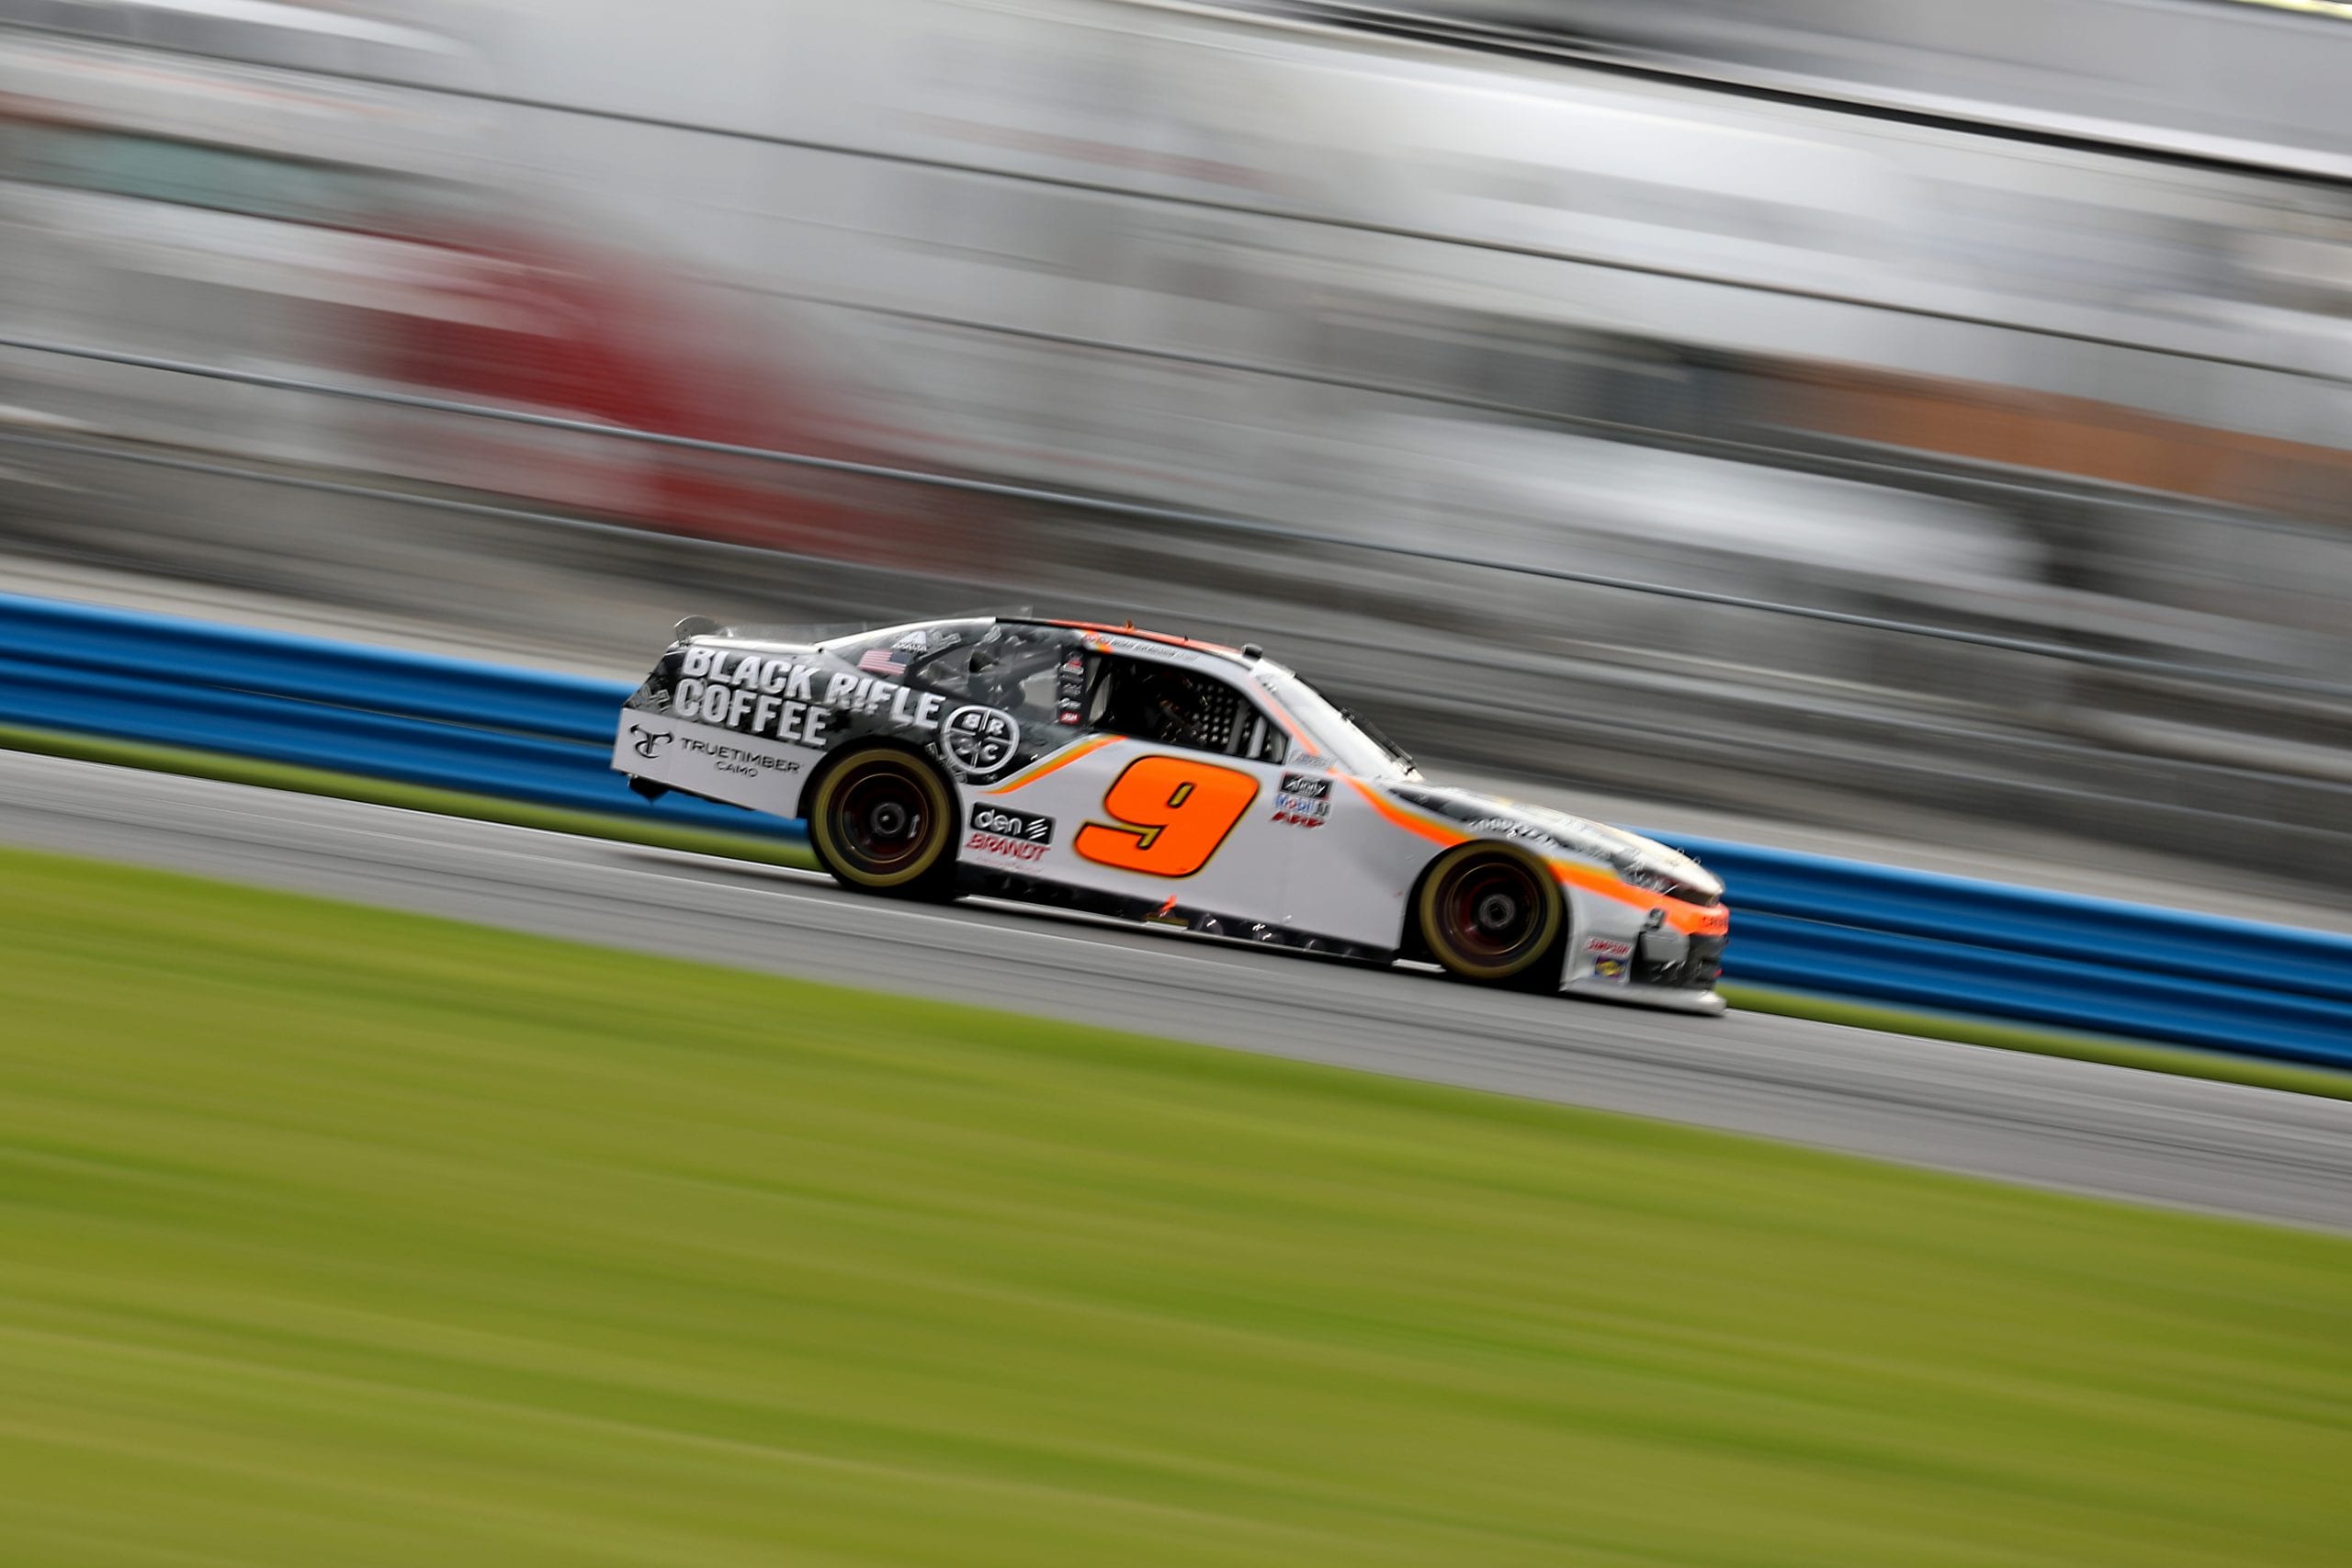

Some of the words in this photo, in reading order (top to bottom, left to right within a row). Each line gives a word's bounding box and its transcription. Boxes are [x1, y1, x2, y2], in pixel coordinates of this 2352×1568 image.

[682, 647, 820, 700] BLACK
[826, 671, 946, 730] RIFLE
[673, 678, 829, 746] COFFEE
[681, 738, 800, 773] TRUETIMBER
[715, 761, 759, 778] CAMO
[1073, 755, 1260, 878] 9
[967, 833, 1051, 863] BRANDT
[1587, 939, 1634, 955] SIMPSON
